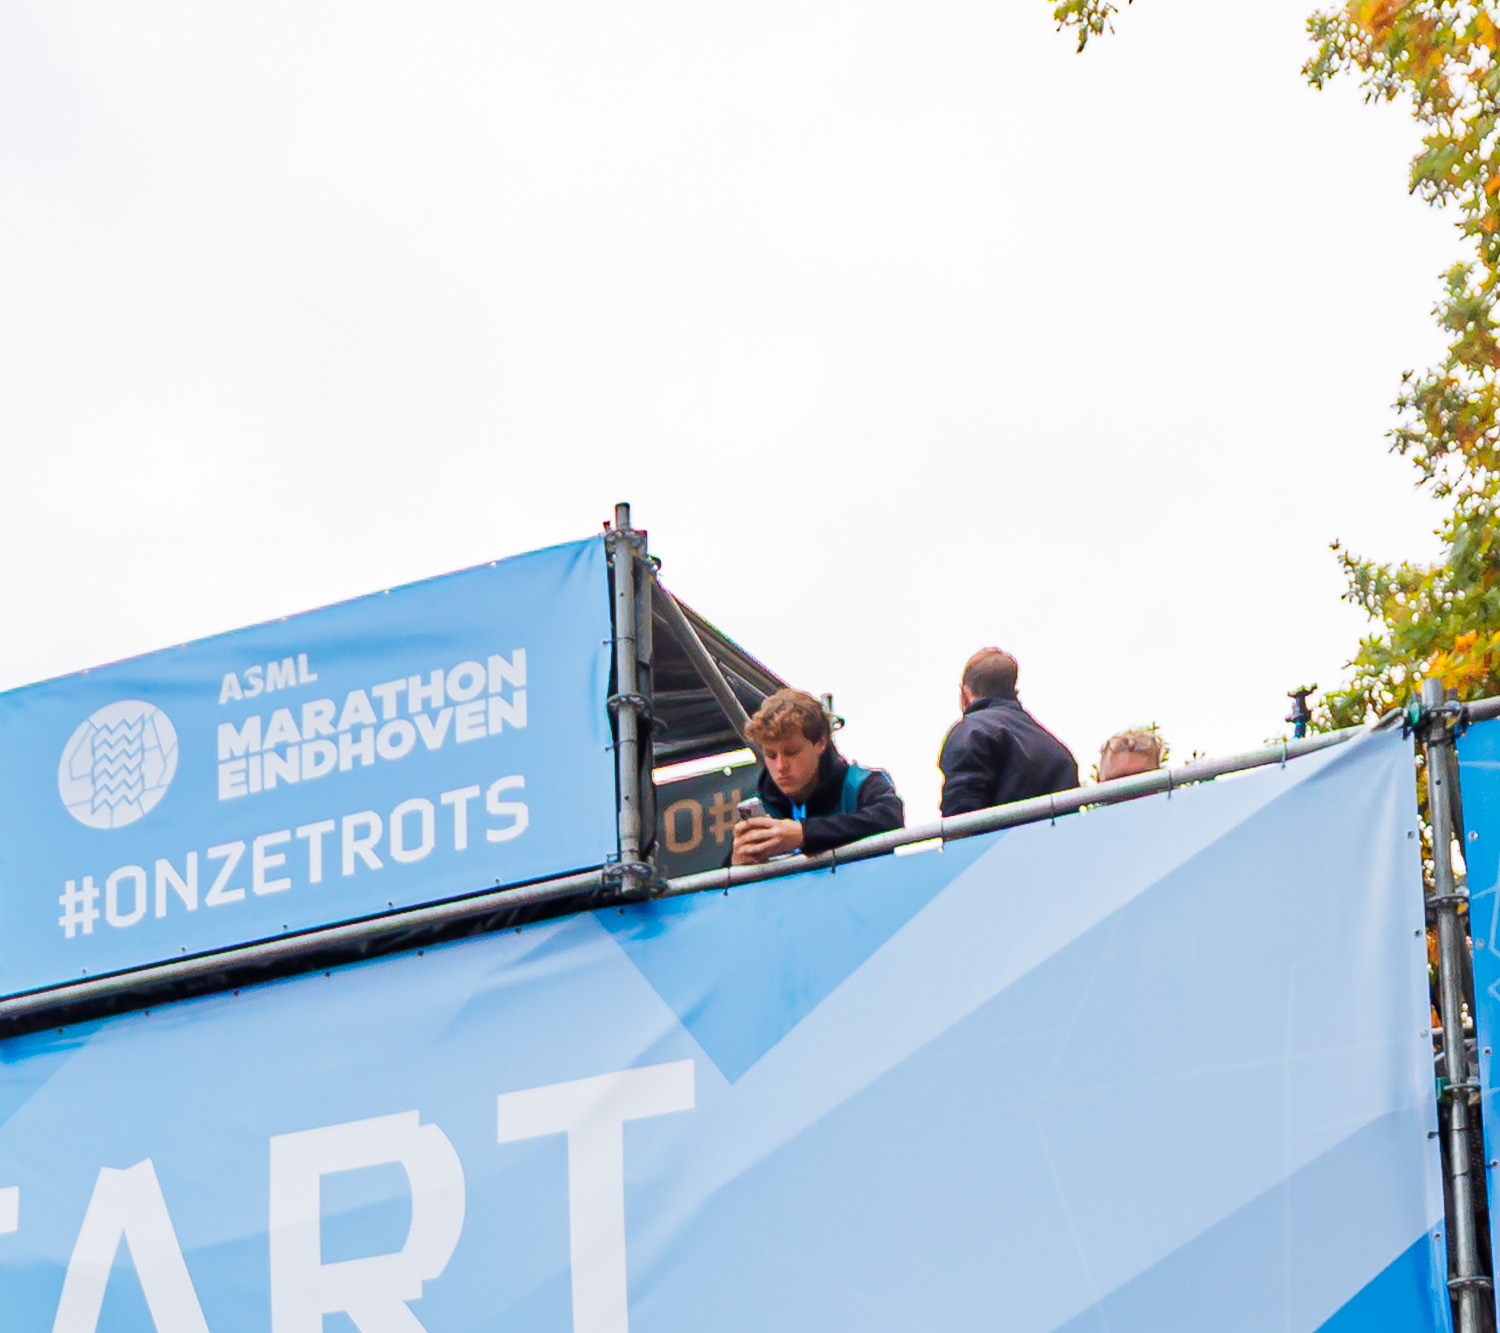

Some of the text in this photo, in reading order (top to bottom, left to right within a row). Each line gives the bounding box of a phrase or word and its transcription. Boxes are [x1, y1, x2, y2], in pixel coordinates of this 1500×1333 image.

[217, 647, 529, 759] MARATHON
[218, 651, 318, 704] ASML
[217, 691, 529, 801] EINDHOVEN
[58, 774, 530, 939] #ONZETROTS
